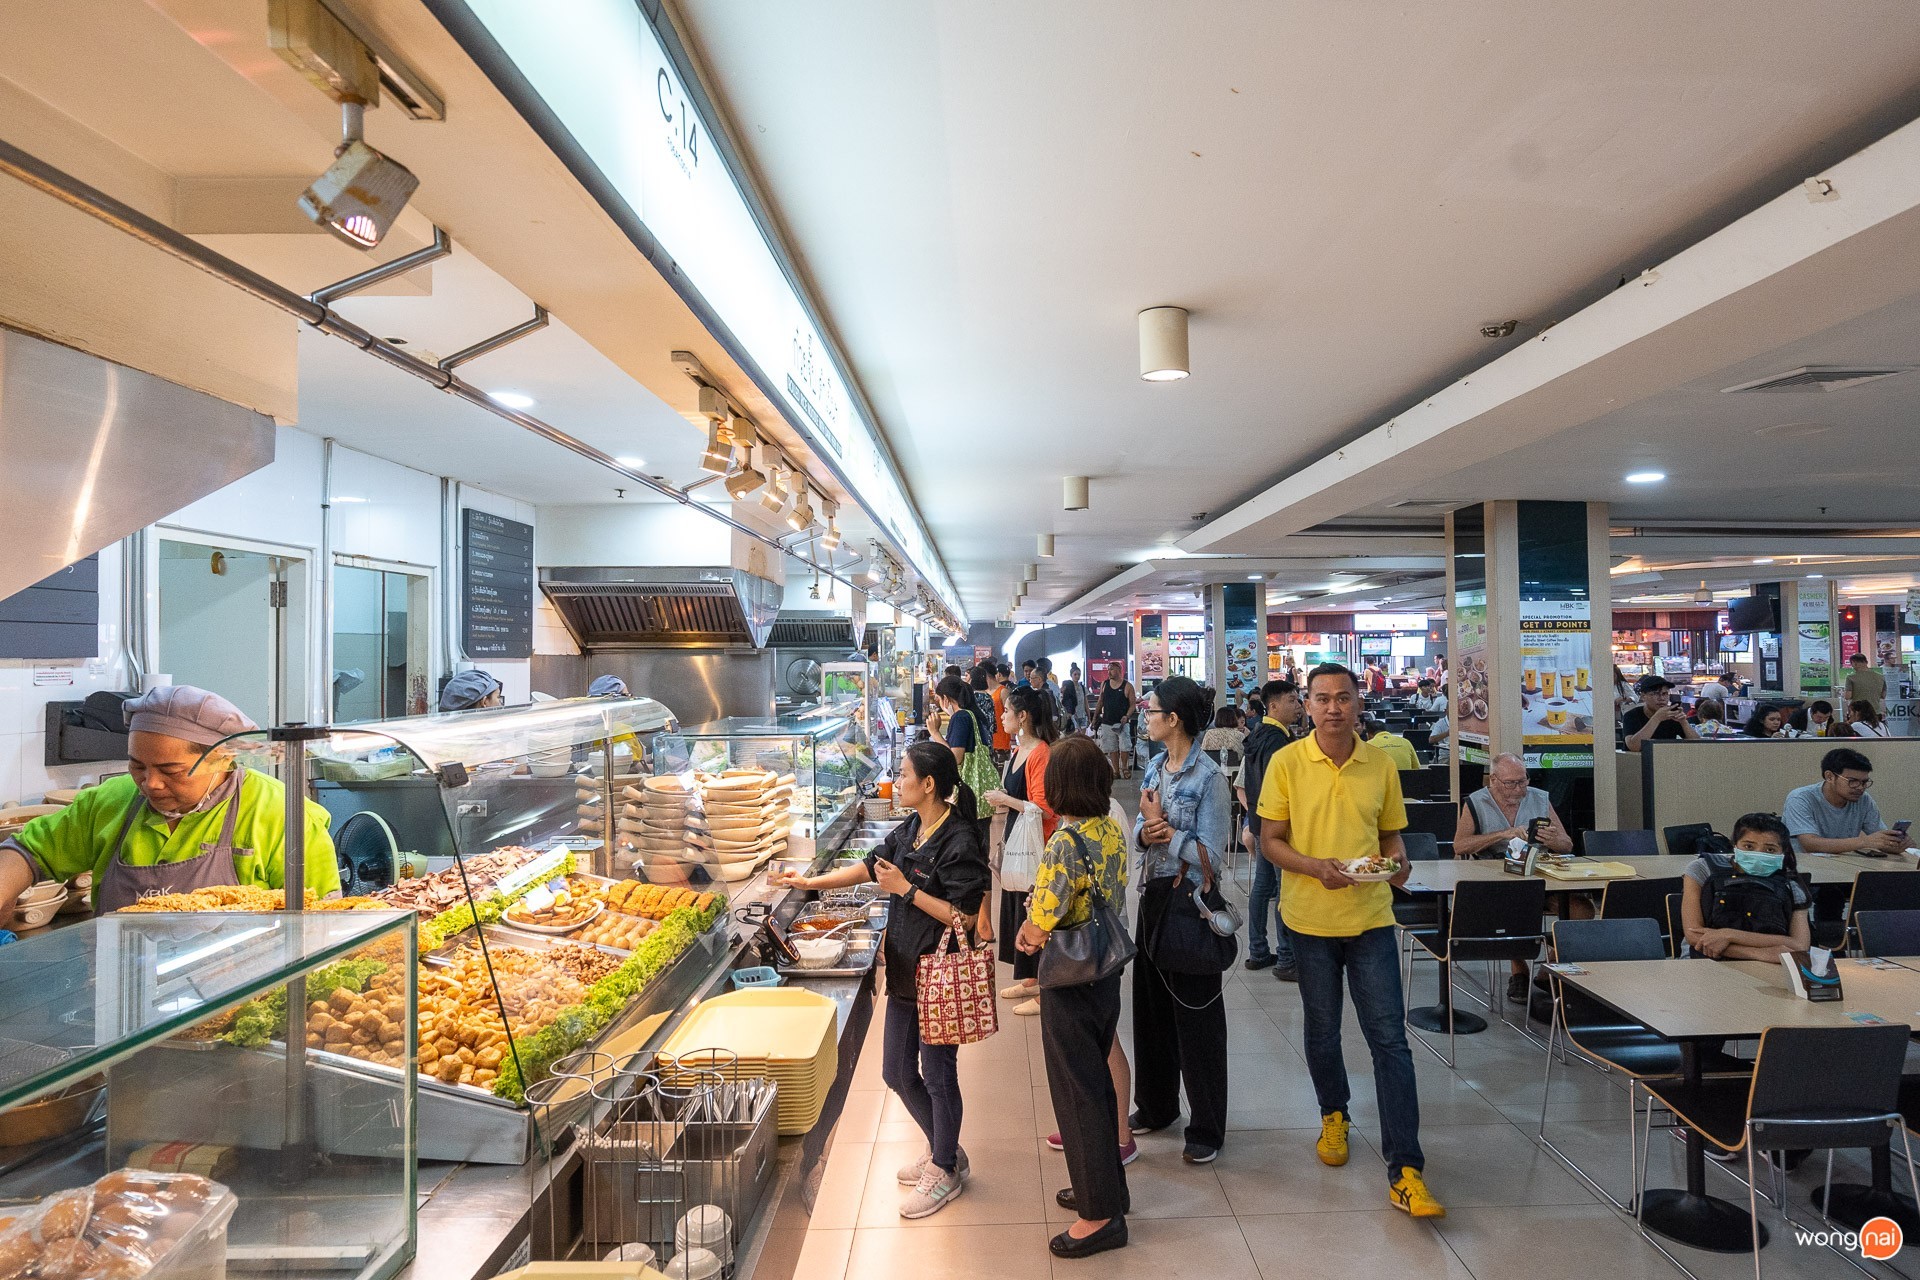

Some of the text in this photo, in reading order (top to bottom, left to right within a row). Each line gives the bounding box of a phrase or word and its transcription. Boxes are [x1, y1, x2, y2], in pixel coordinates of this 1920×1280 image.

[658, 67, 697, 168] C.14
[1886, 704, 1916, 717] MBK
[135, 885, 174, 903] MBK
